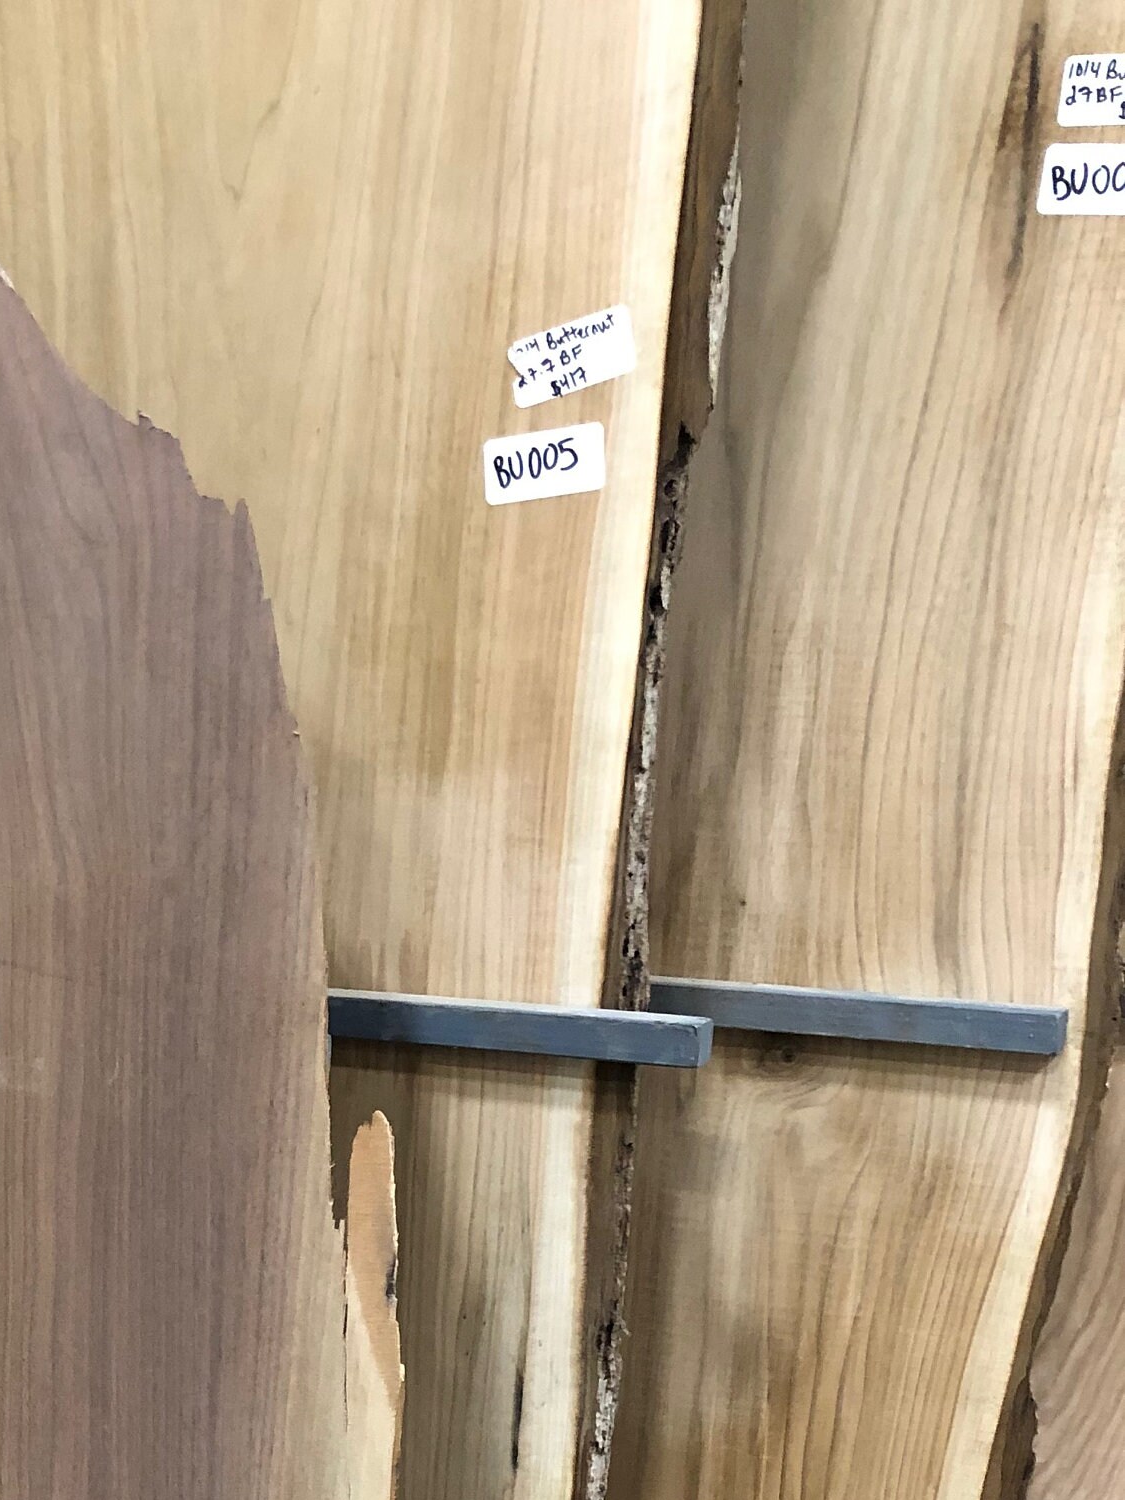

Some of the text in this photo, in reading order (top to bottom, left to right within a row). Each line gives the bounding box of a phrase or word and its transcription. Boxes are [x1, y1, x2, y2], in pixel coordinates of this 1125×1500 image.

[546, 313, 614, 351] Butternut
[559, 344, 583, 366] BF
[550, 366, 588, 398] $417
[493, 437, 579, 489] BU005
